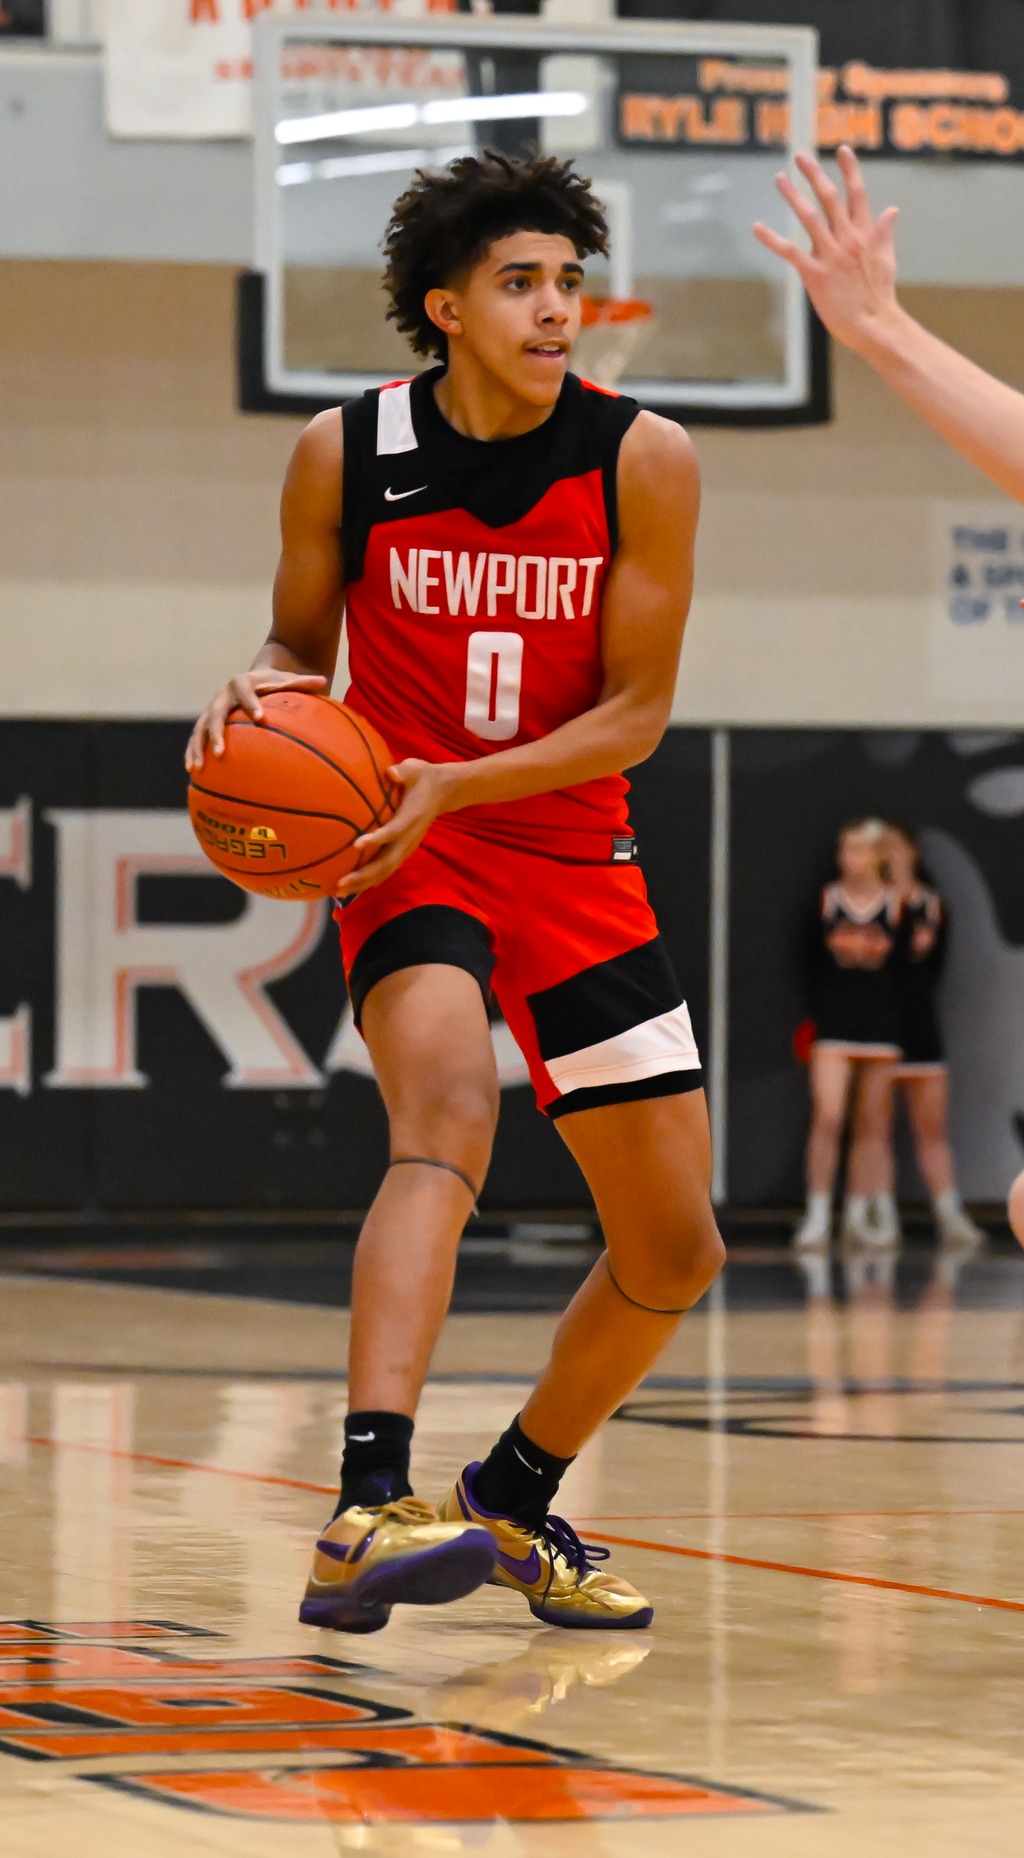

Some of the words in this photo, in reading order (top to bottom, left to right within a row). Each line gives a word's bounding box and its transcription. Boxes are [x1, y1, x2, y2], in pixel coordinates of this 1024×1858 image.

[621, 92, 747, 143] RYLE
[755, 98, 881, 148] HGH
[389, 547, 604, 620] NEWPORT
[464, 631, 524, 741] 0
[193, 823, 288, 860] LEGAC
